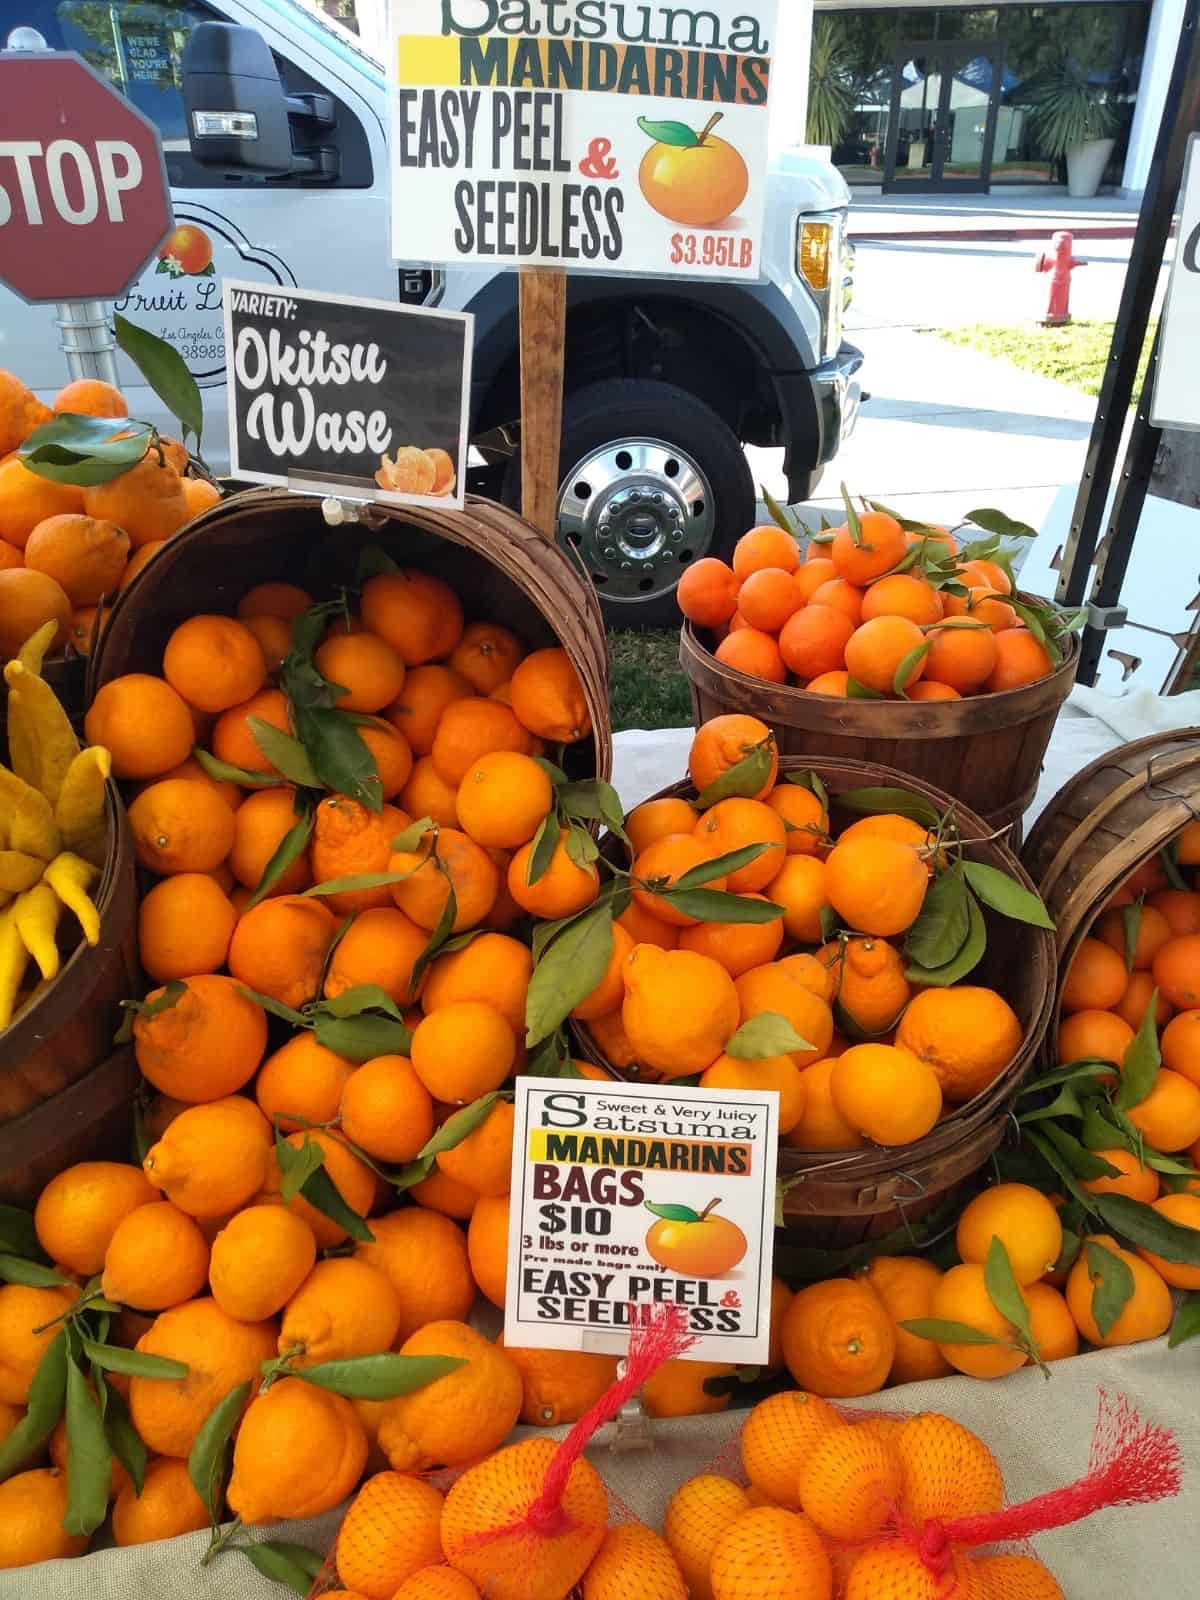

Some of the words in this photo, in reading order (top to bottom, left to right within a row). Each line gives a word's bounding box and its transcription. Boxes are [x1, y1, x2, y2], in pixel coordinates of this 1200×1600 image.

[459, 36, 769, 105] MANDARINS
[399, 89, 481, 169] EASY
[492, 91, 571, 172] PEEL
[578, 137, 619, 180] &
[0, 139, 142, 226] TOP
[454, 180, 624, 260] SEEDLESS
[670, 233, 753, 268] $3.95LB
[114, 282, 187, 311] Fruit
[231, 291, 298, 320] VARIETY:
[235, 327, 387, 389] Okitsu
[246, 387, 392, 456] Wase
[597, 1100, 648, 1114] Sweet
[654, 1104, 666, 1115] &
[672, 1106, 710, 1121] Very
[717, 1109, 757, 1122] Juicy
[546, 1134, 748, 1174] MANDARINS
[533, 1164, 645, 1206] BAGS
[538, 1203, 612, 1236] $10
[523, 1235, 533, 1249] 3
[539, 1235, 565, 1250] lbs
[571, 1241, 589, 1252] or
[594, 1243, 639, 1257] more
[553, 1257, 592, 1266] made
[597, 1260, 632, 1270] bags
[636, 1263, 668, 1273] only
[523, 1268, 616, 1299] EASY
[629, 1276, 718, 1306] PEEL
[720, 1290, 742, 1308] &
